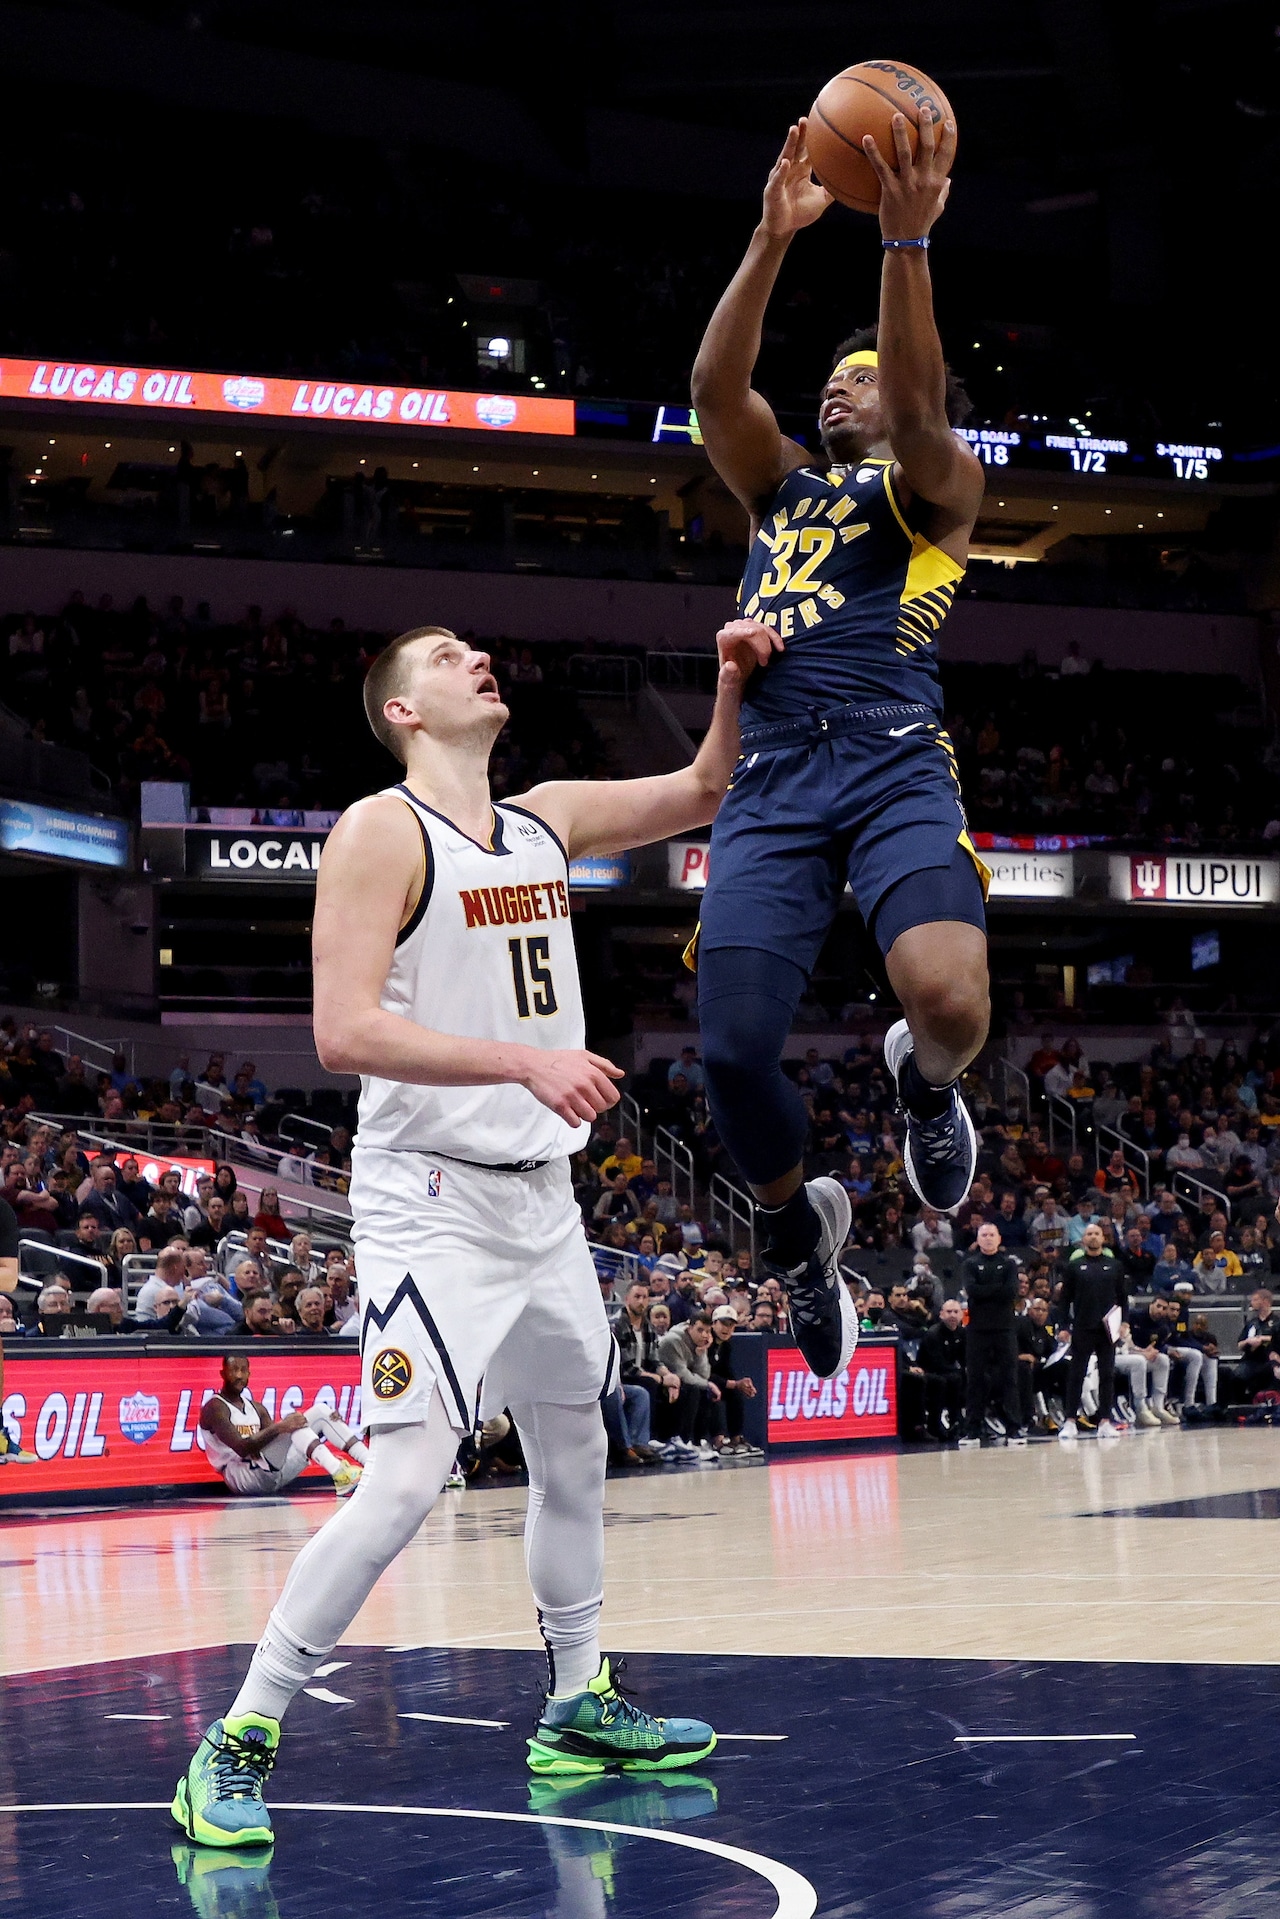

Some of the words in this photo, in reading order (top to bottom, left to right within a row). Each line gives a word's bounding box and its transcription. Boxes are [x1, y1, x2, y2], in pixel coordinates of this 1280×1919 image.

[28, 364, 138, 400] LUCAS
[141, 372, 194, 404] OIL
[291, 384, 395, 419] LUCAS
[399, 391, 448, 422] OIL
[952, 428, 978, 441] ELD
[979, 430, 1021, 445] GOALS
[973, 443, 1009, 466] /18
[1045, 435, 1077, 449] FREE
[1077, 437, 1129, 453] THROWS
[1156, 443, 1204, 459] 3-POINT
[1070, 450, 1107, 473] 1/2
[1173, 458, 1208, 480] 1/5
[757, 494, 871, 549] INDINA
[758, 526, 836, 599] 32
[569, 865, 591, 878] able
[1175, 862, 1261, 897] IUPUI
[459, 880, 570, 930] NUGGETS
[507, 934, 560, 1021] 15
[768, 1370, 849, 1420] LUCAS
[853, 1367, 889, 1417] OIL
[34, 1391, 107, 1461] OIL
